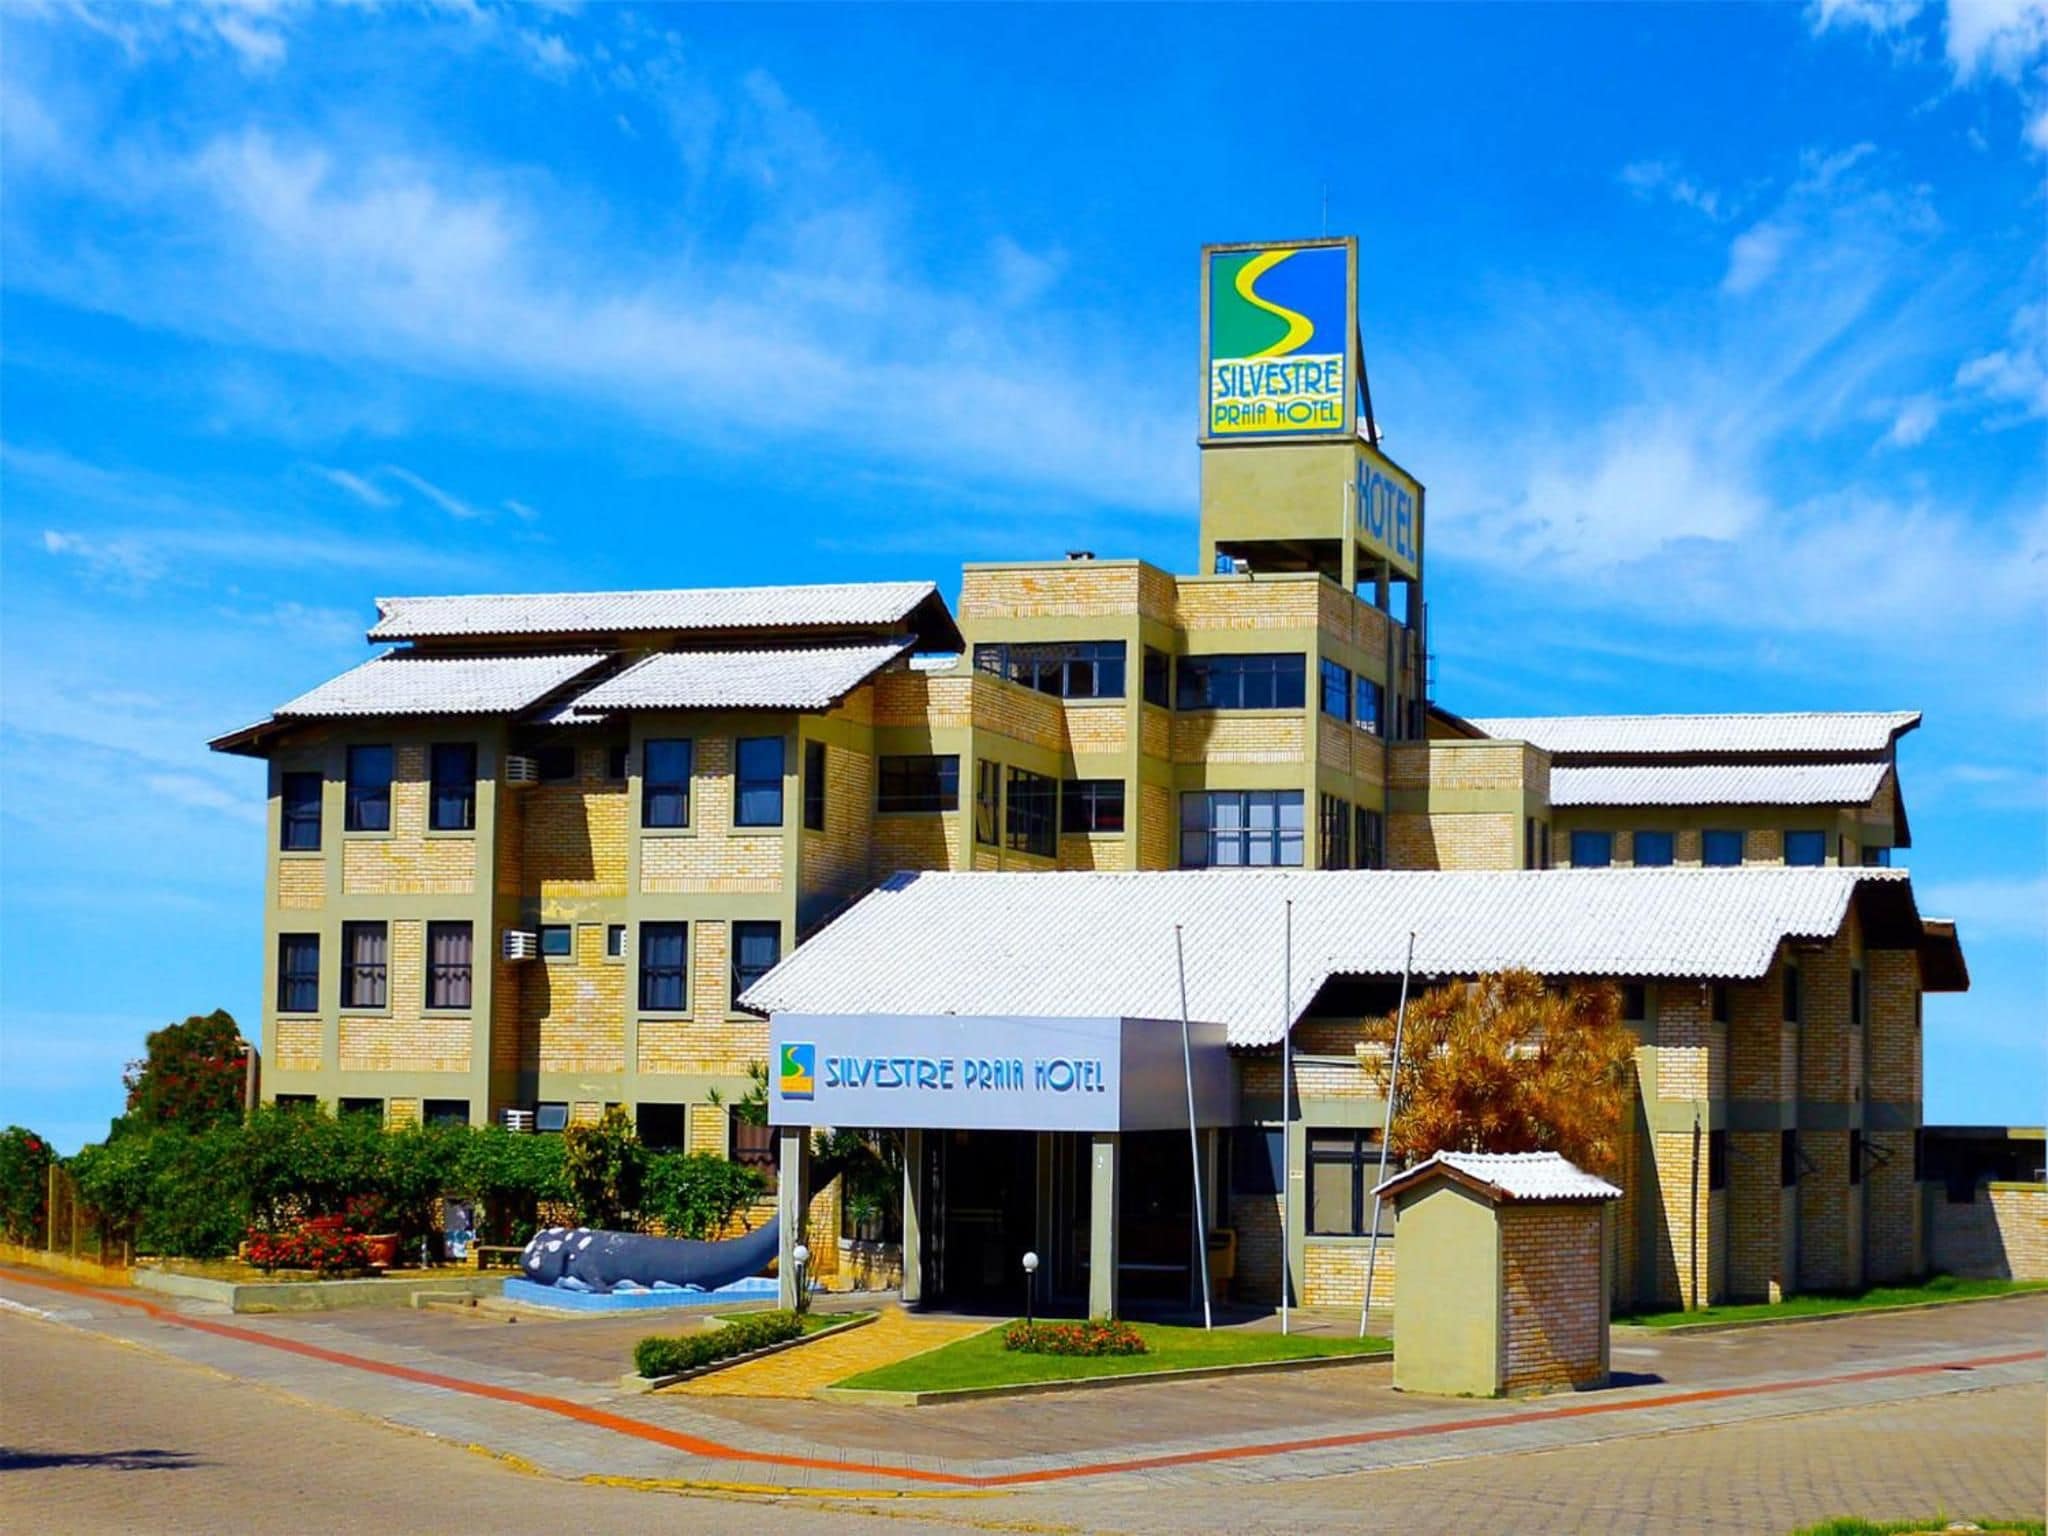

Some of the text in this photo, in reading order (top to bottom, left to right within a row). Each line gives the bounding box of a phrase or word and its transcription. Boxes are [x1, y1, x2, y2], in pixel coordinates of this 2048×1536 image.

[1217, 361, 1338, 399] SILVESTRE
[1214, 401, 1337, 426] PRAIA HOTEL
[1357, 459, 1415, 562] HOTEL
[825, 1056, 1105, 1093] SILVESTRE PRAIA HOTEL
